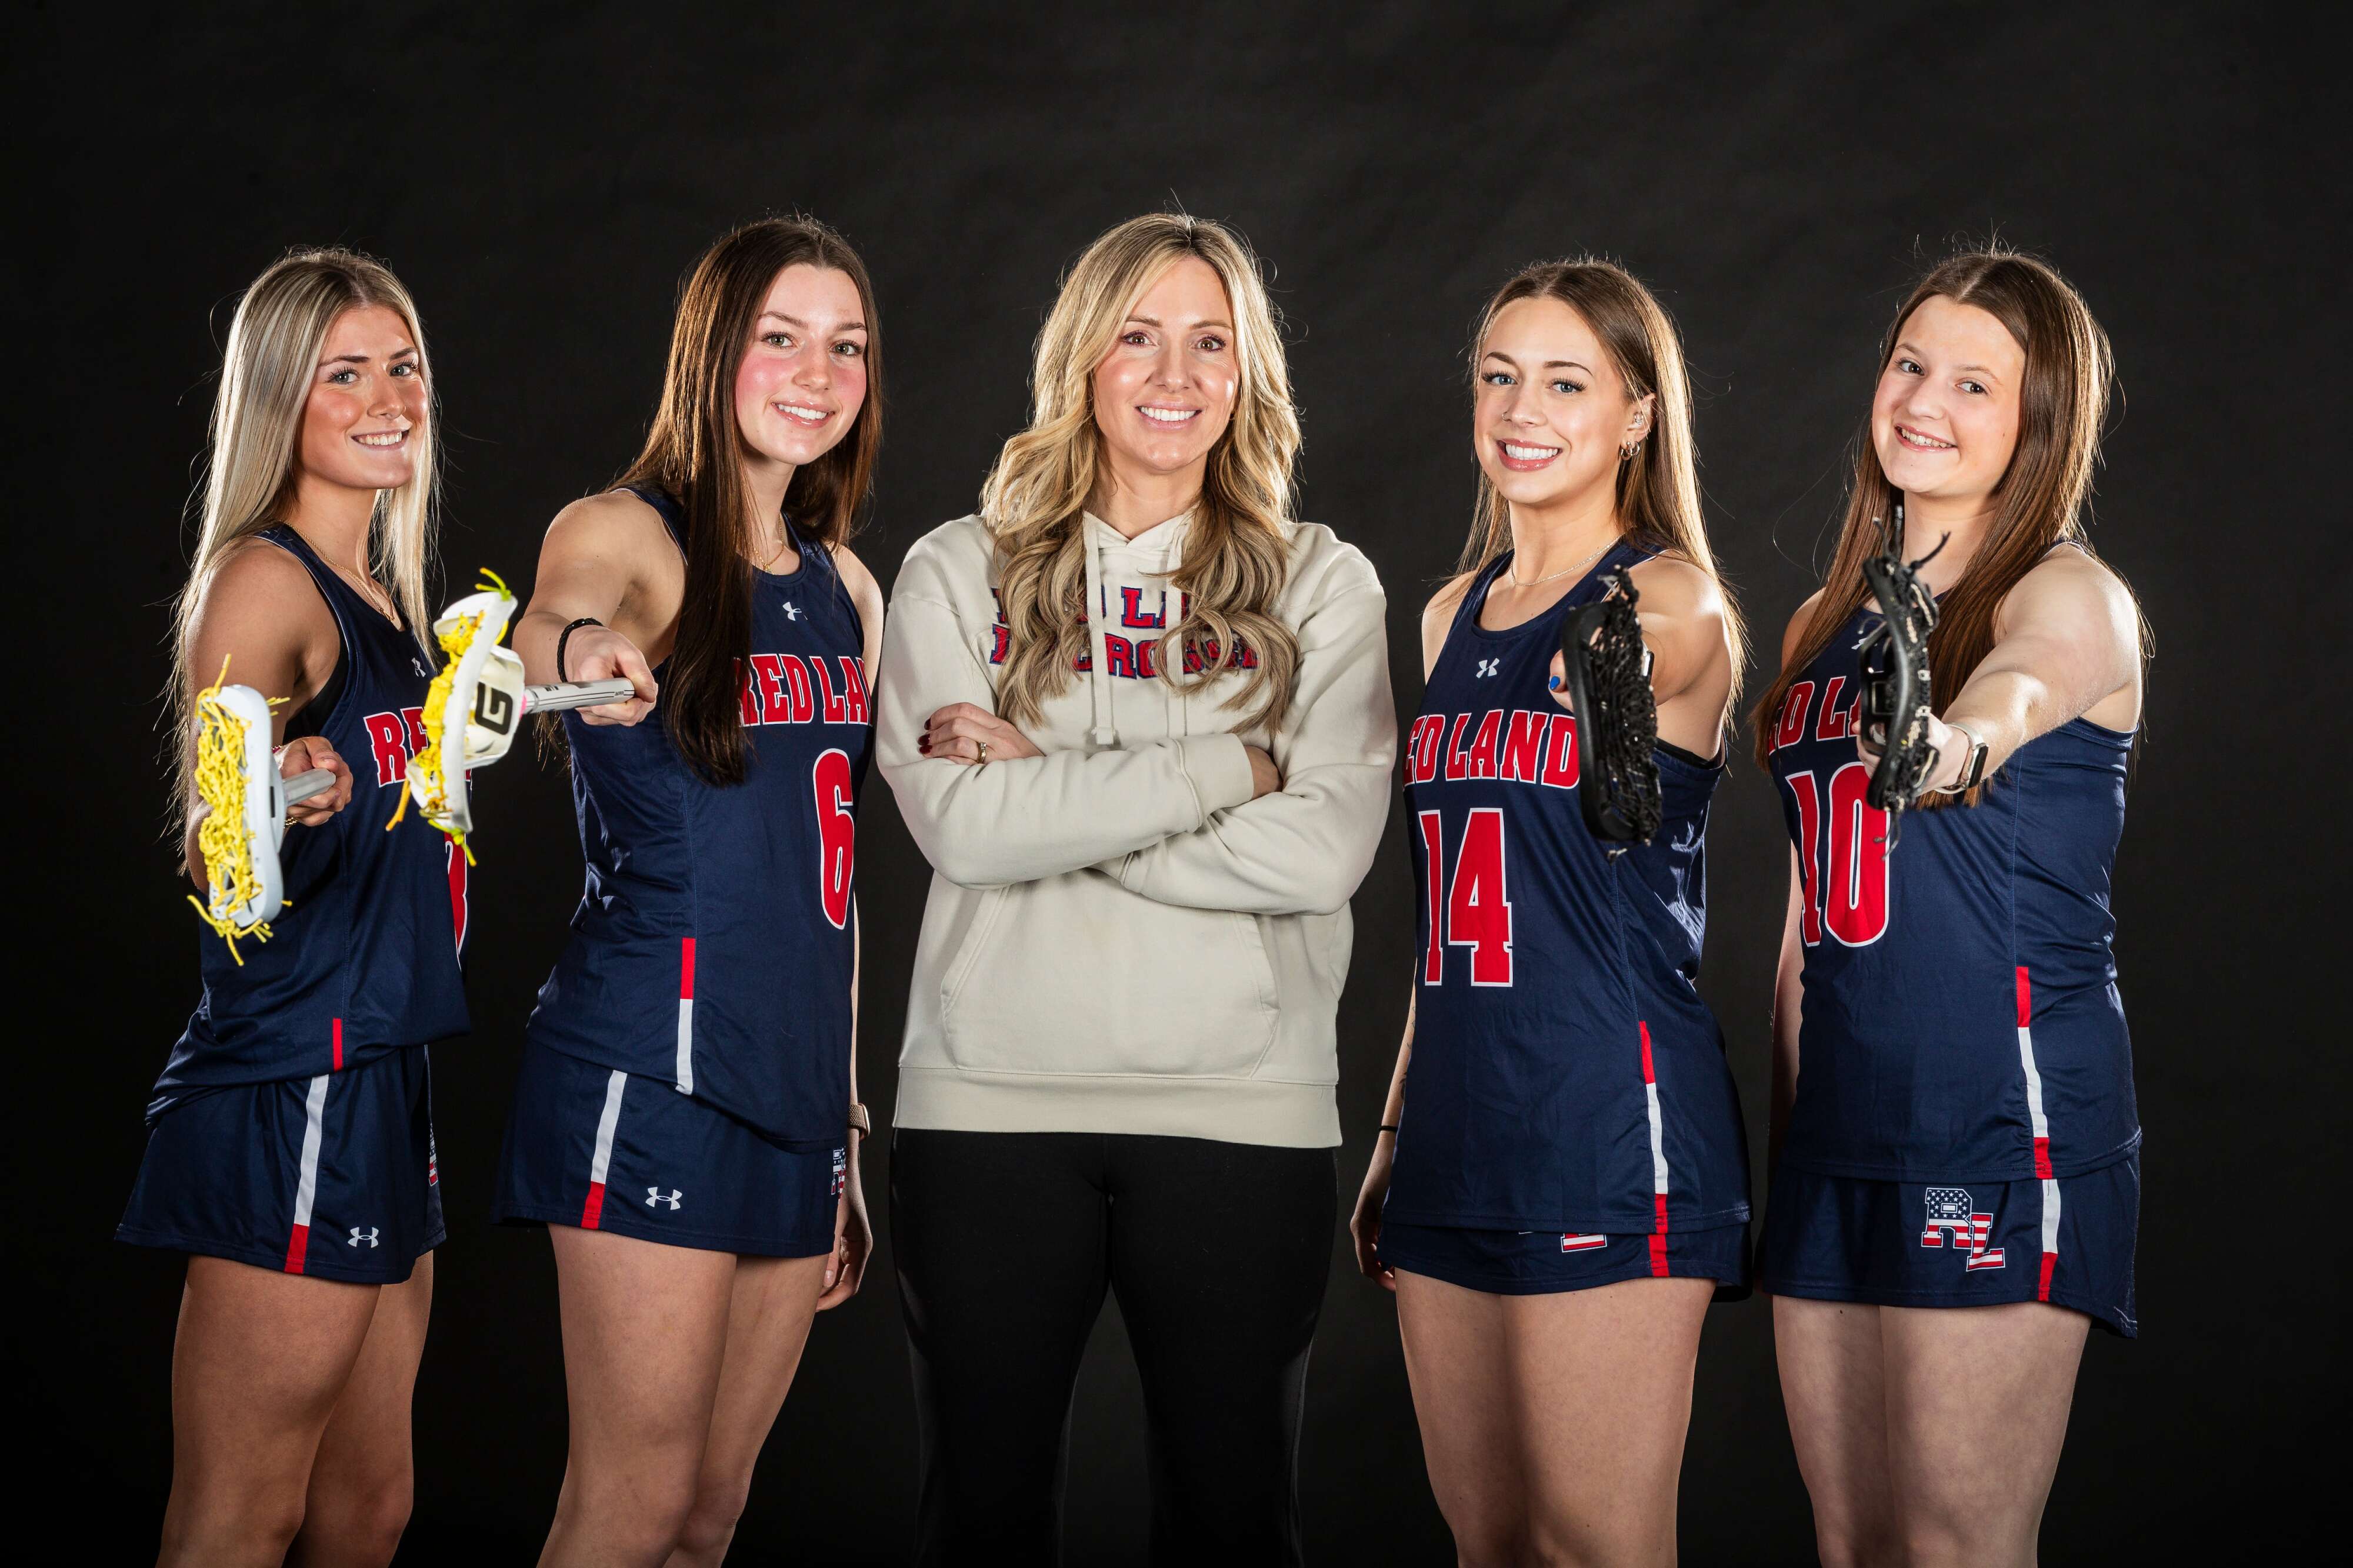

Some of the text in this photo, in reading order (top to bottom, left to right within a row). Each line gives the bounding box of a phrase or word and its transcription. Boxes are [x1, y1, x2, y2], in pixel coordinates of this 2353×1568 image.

[809, 656, 872, 726] LA
[1445, 709, 1580, 789] LAND
[813, 748, 854, 930] 6
[1418, 808, 1513, 987] 14
[1785, 761, 1890, 948] 10
